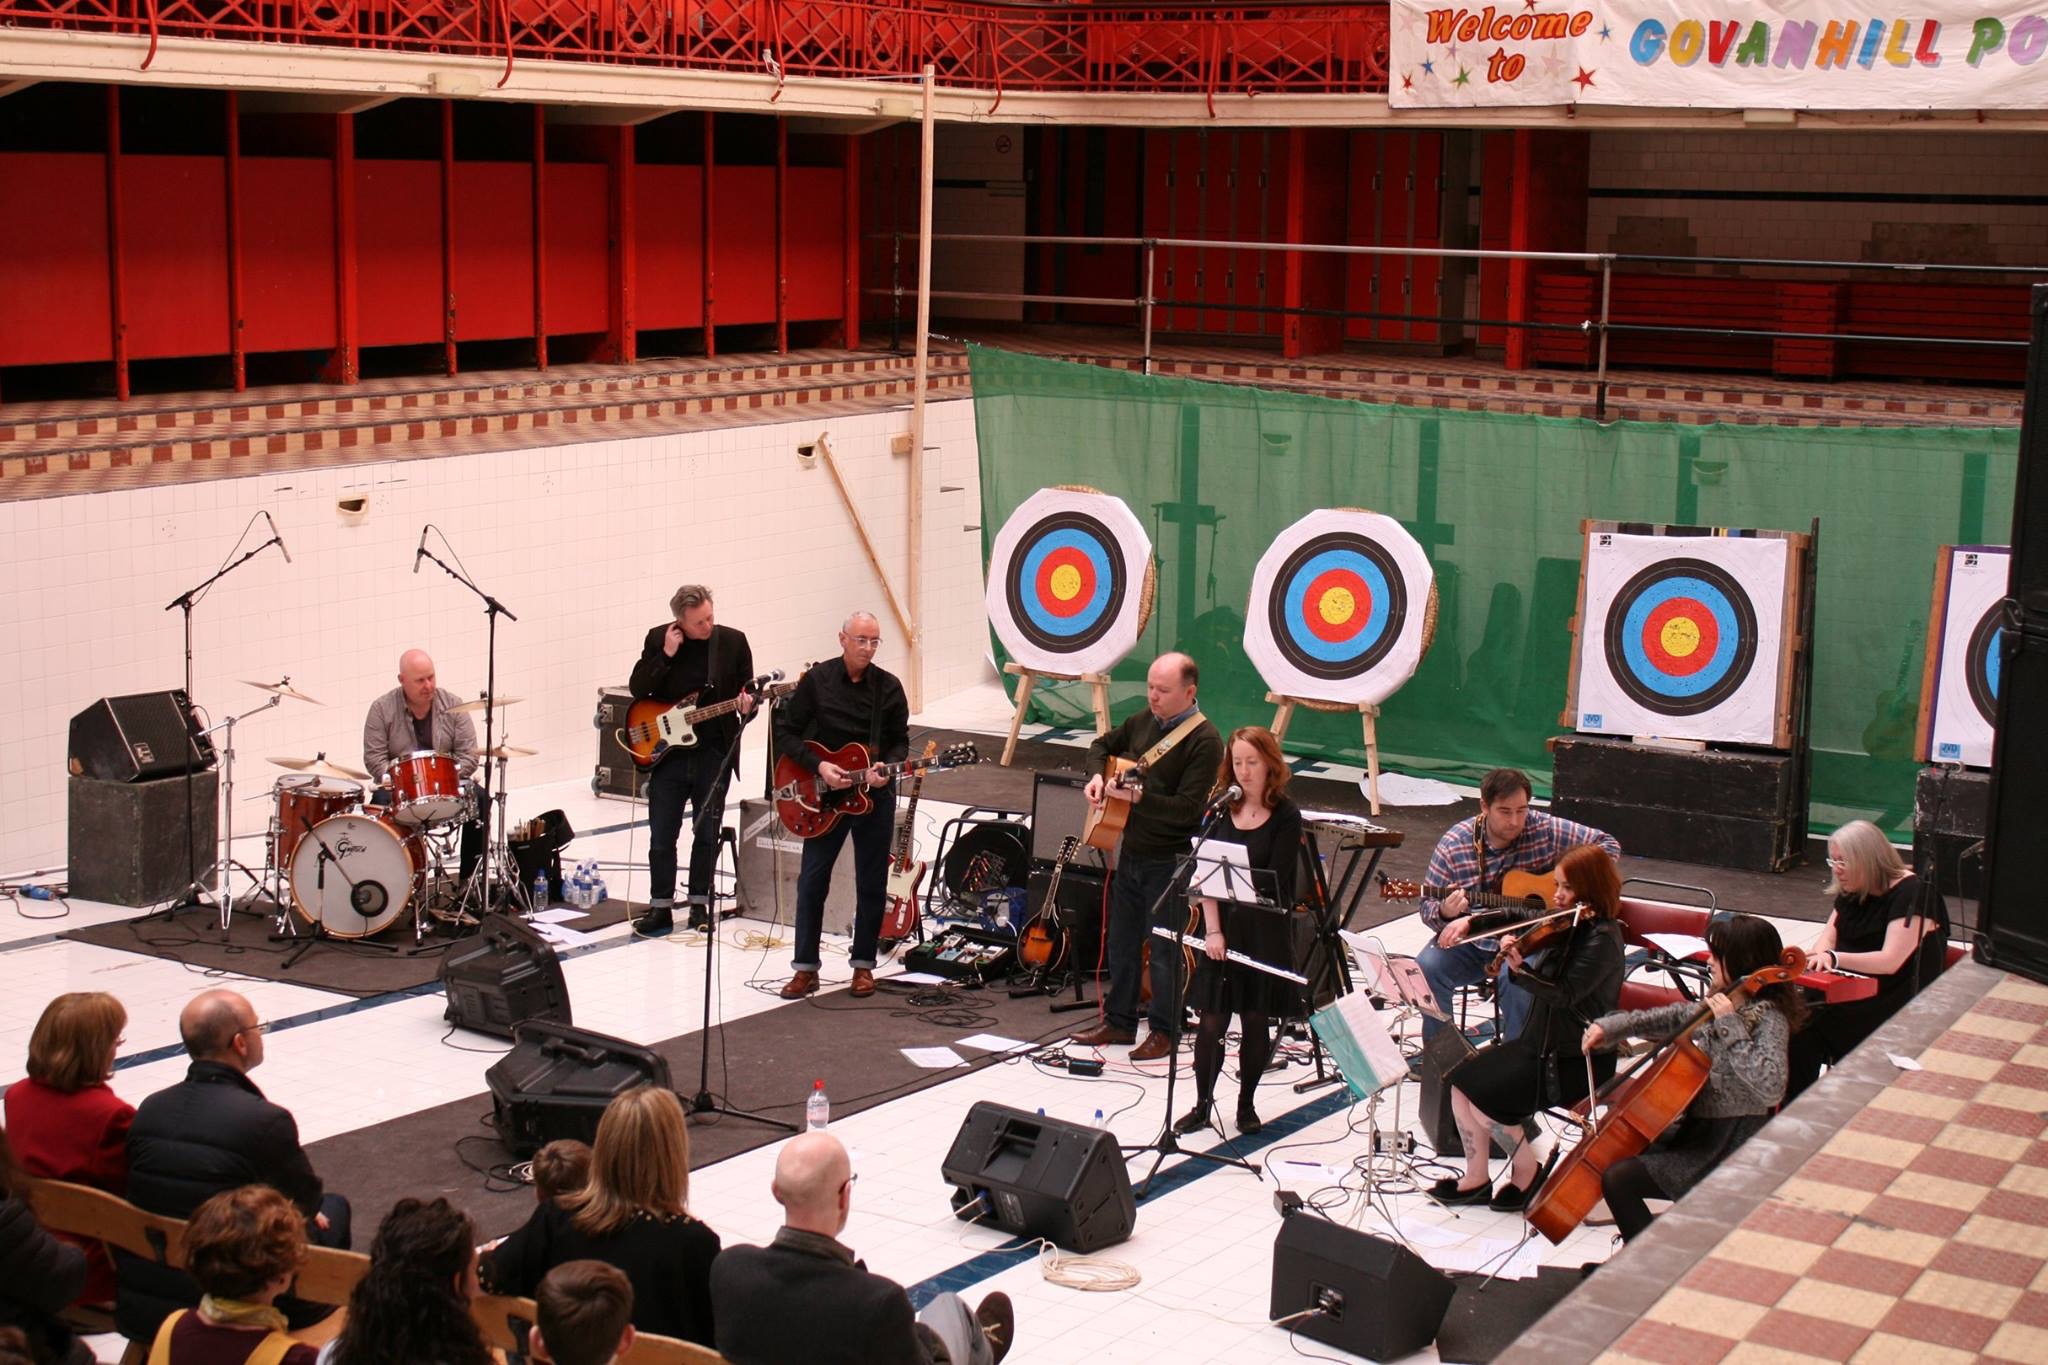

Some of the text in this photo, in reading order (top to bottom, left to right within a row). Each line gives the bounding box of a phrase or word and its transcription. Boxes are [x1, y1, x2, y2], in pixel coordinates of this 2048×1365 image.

[1425, 6, 1593, 44] Welcome
[1629, 18, 1942, 69] GOVANHILL
[1487, 47, 1526, 83] to
